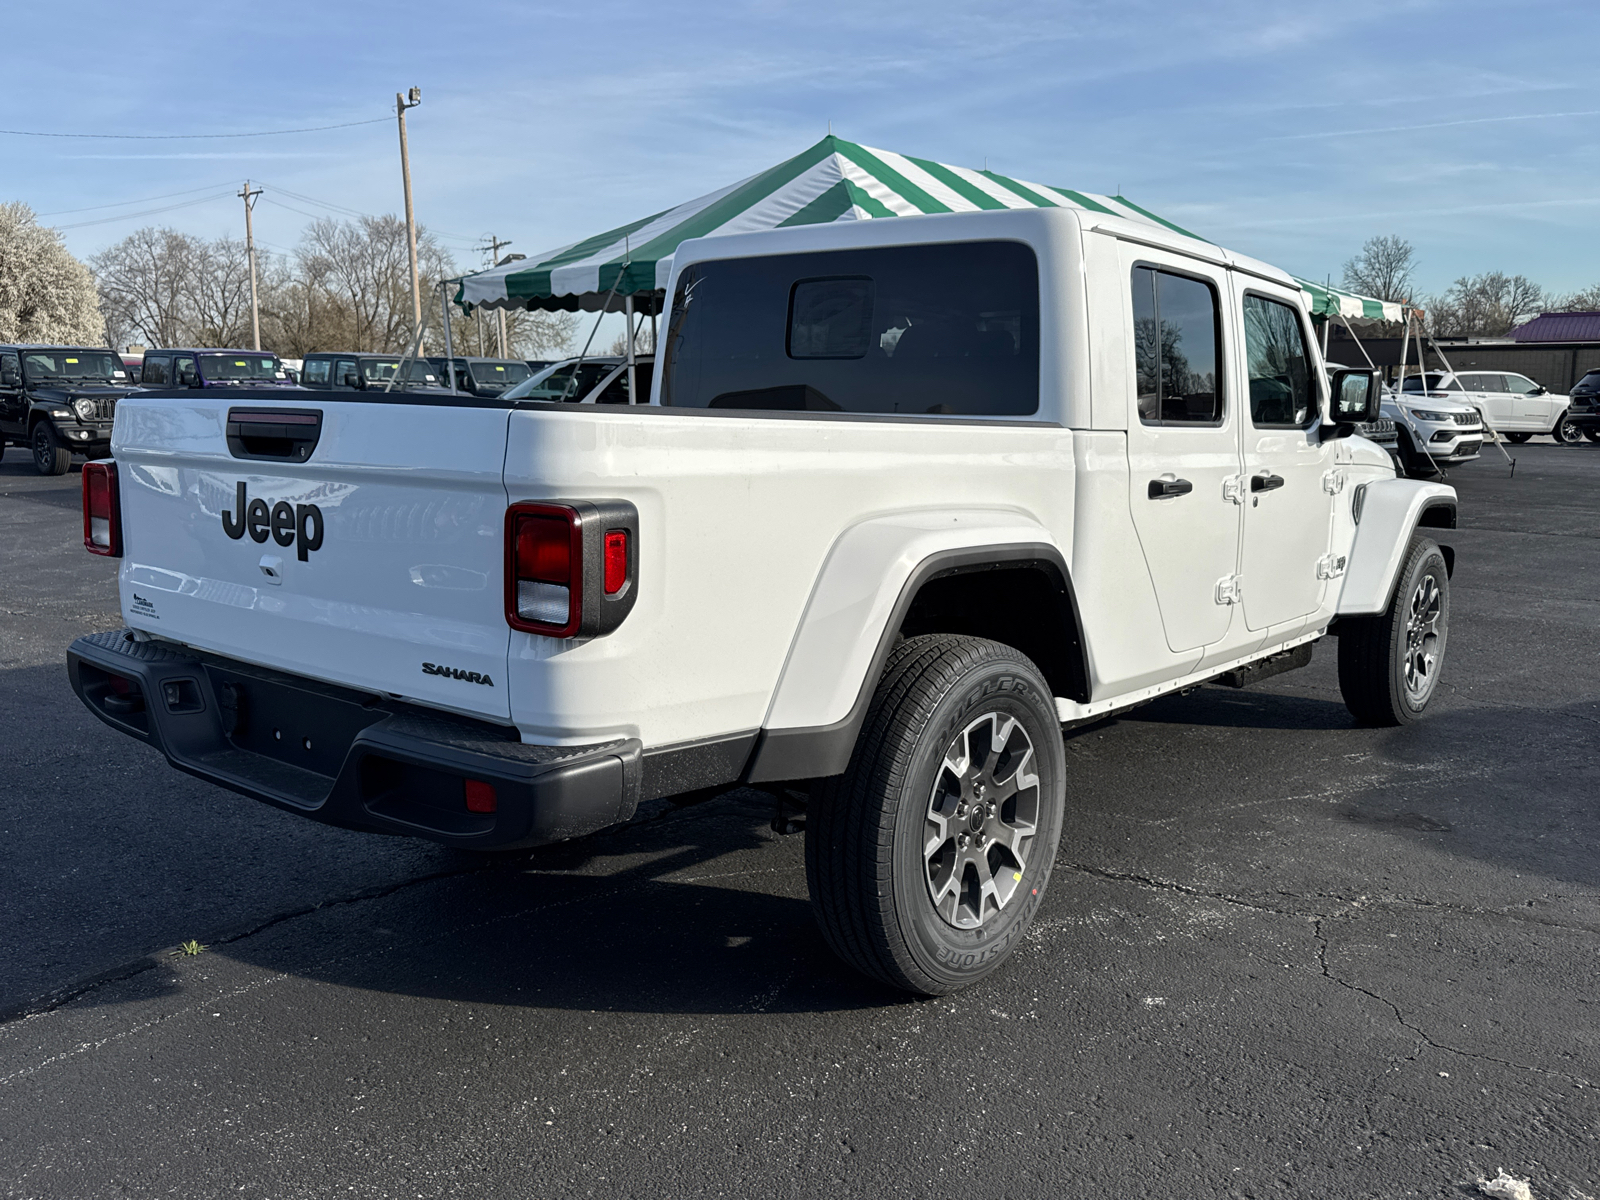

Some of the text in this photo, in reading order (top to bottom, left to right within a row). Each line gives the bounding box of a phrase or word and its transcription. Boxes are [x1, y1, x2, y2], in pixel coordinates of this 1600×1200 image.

[222, 481, 324, 562] Jeep
[422, 662, 494, 687] SAHARA
[934, 676, 1029, 763] DUELER
